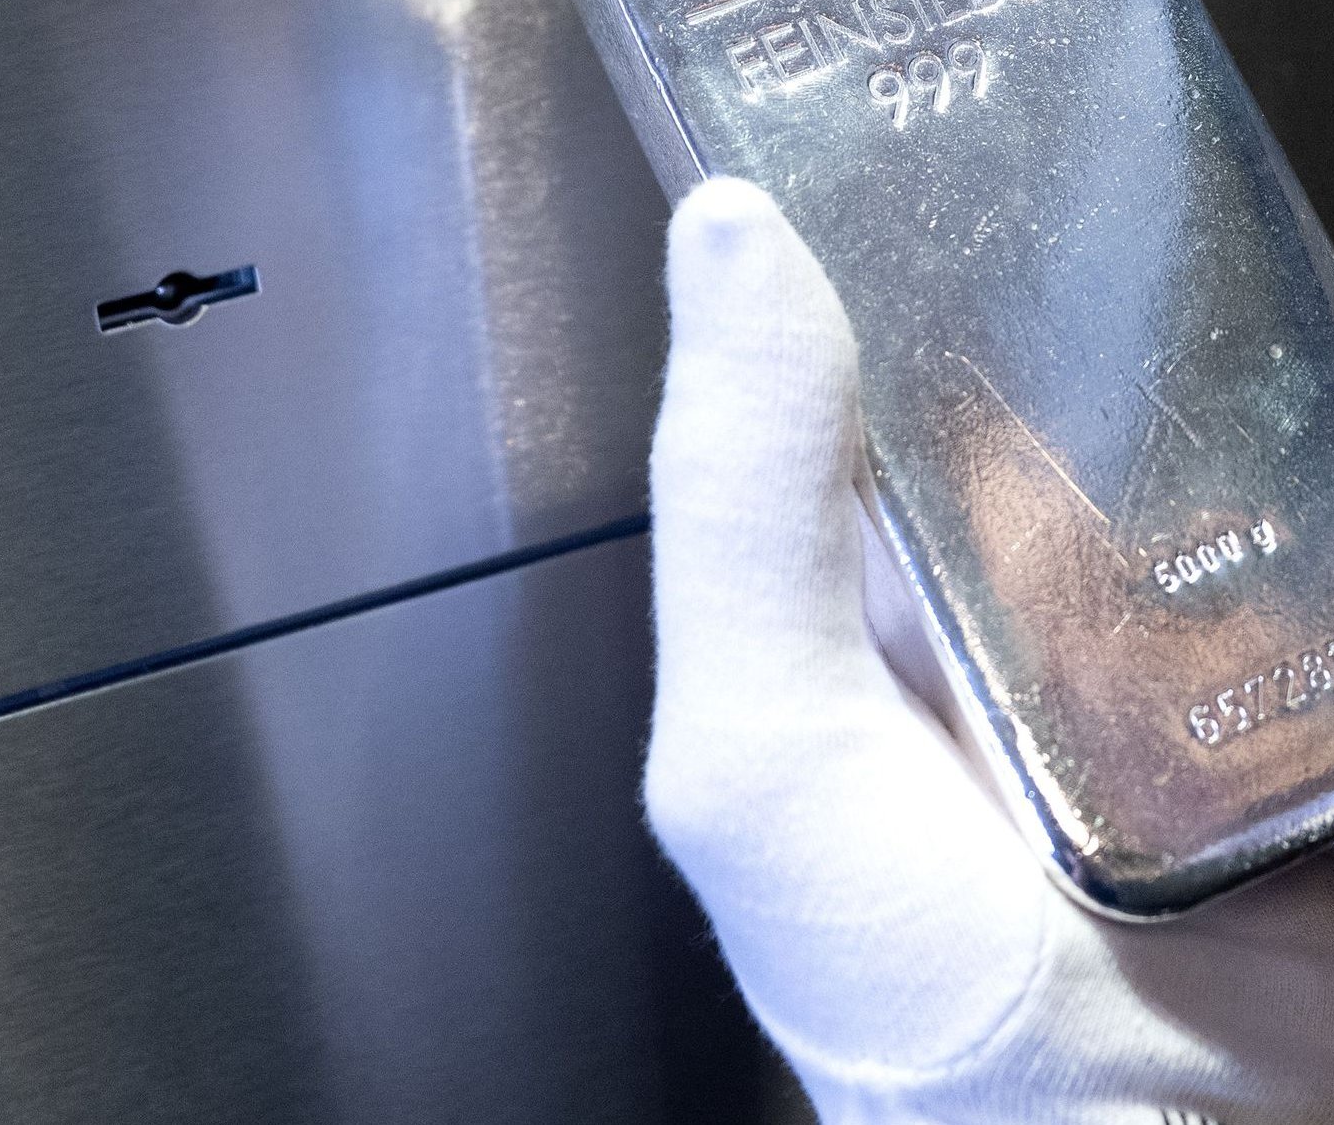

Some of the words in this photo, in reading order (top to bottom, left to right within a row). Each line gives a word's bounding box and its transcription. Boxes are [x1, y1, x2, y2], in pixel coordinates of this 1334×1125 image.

[868, 39, 988, 130] 999
[1153, 530, 1244, 594] 5000
[1249, 518, 1278, 555] g
